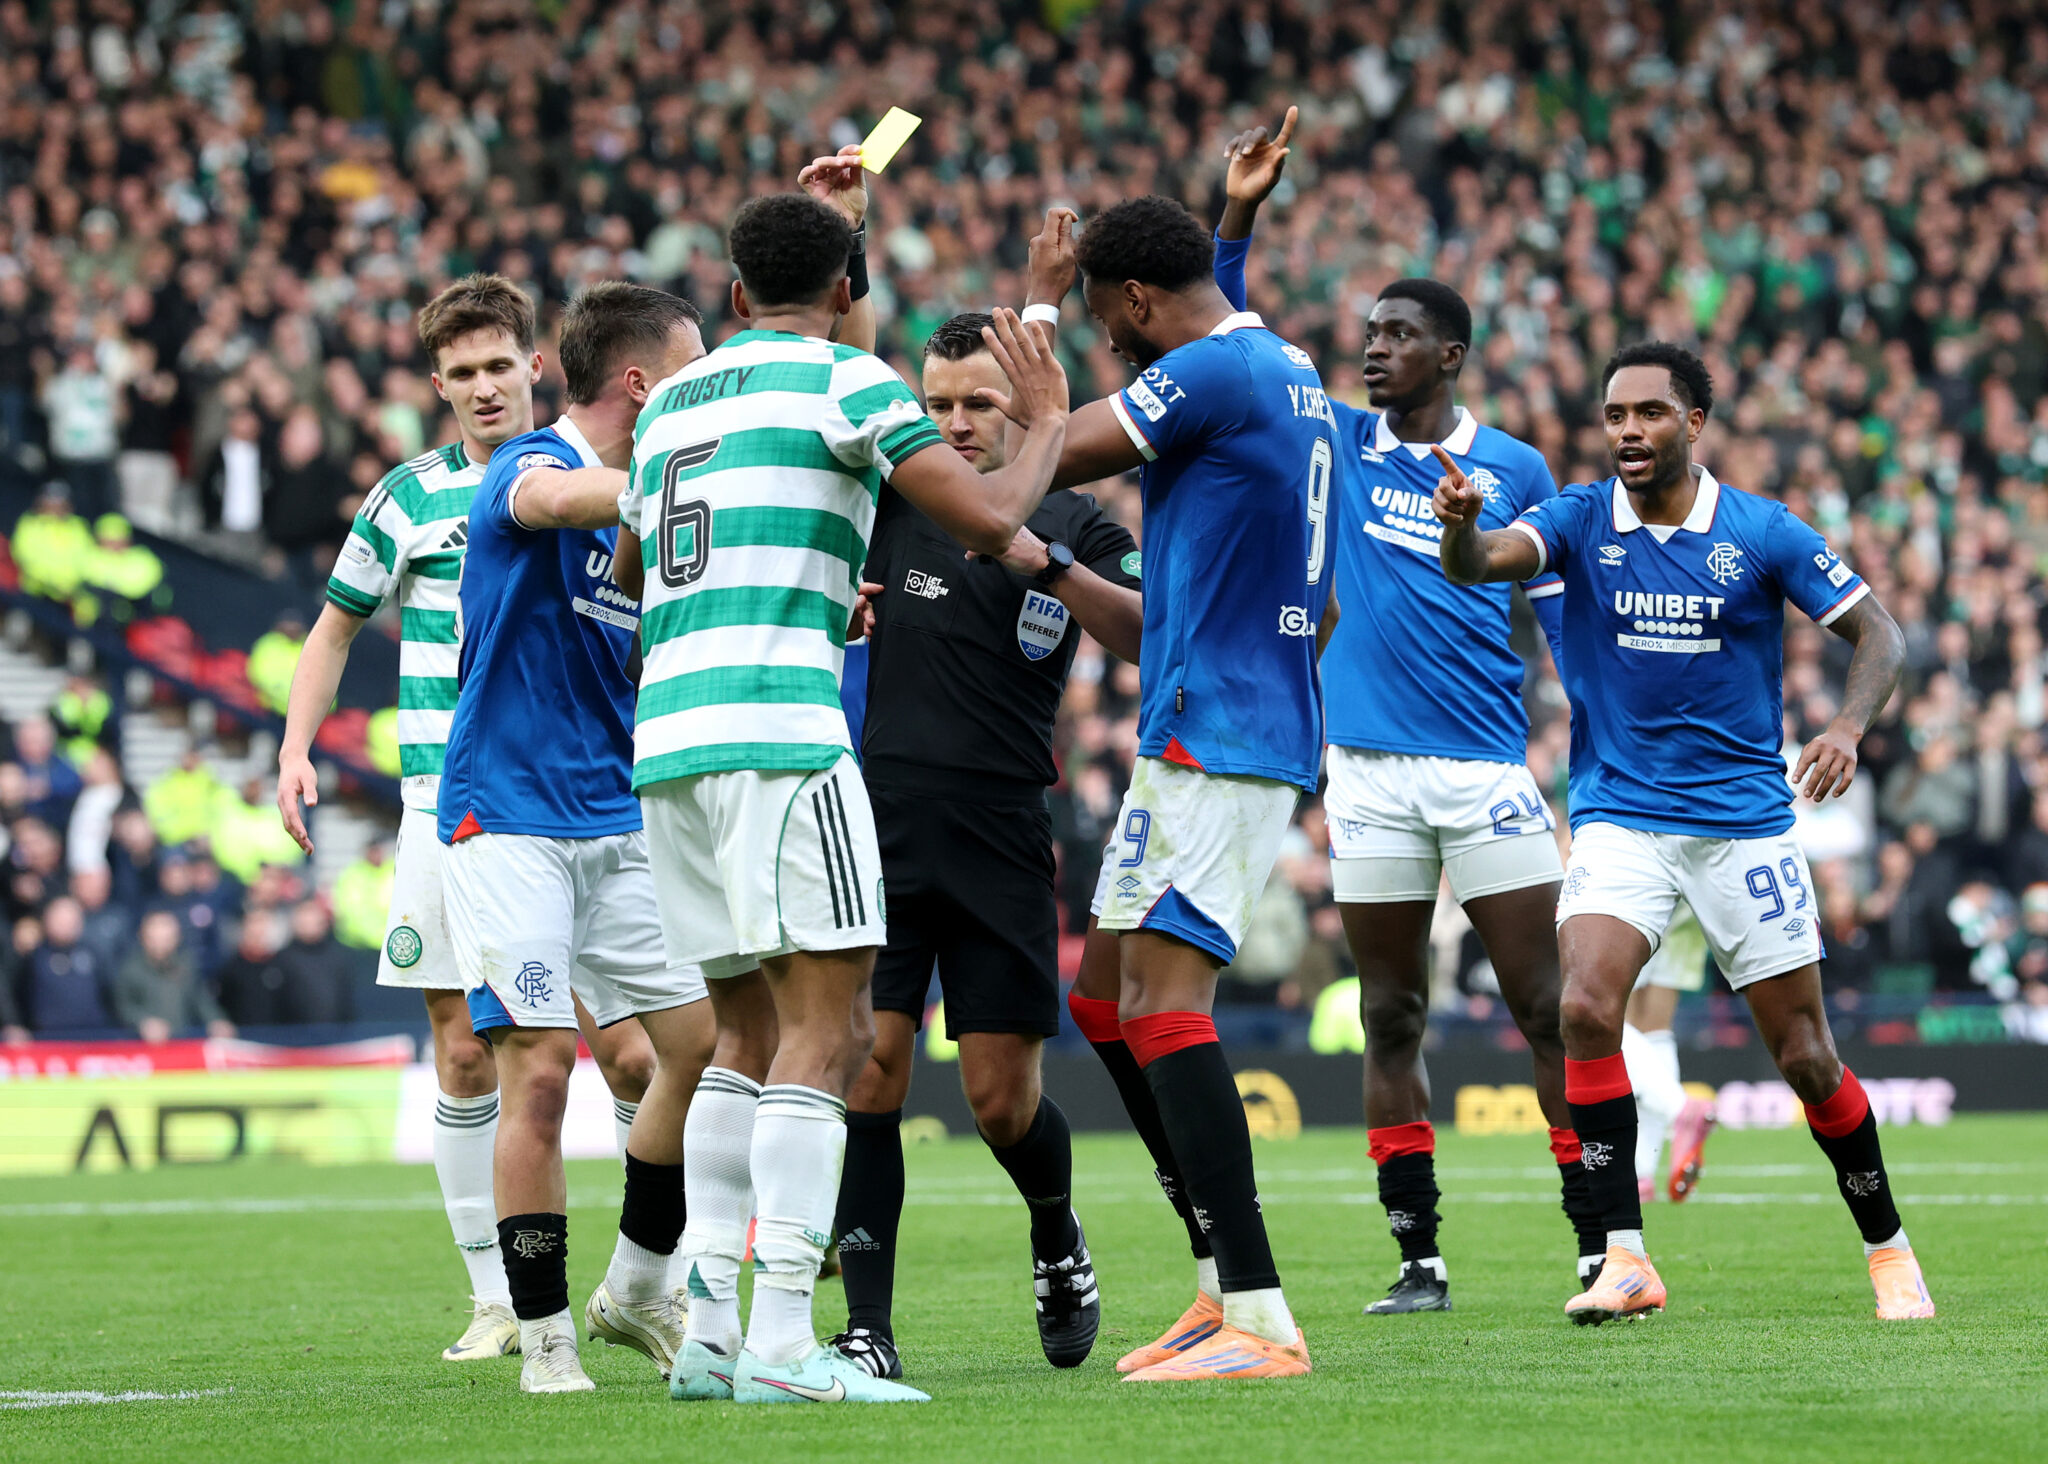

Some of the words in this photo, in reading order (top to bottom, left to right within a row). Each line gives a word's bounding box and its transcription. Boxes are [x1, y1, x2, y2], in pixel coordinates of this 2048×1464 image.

[662, 366, 755, 412] TRUSTY
[1286, 384, 1337, 433] Y.CHE
[658, 436, 723, 591] 6
[1306, 436, 1333, 585] 9
[1371, 486, 1442, 522] UNIB
[1598, 557, 1622, 566] umbro
[585, 604, 610, 620] ZERO%
[1027, 595, 1065, 621] FIFA
[1615, 590, 1725, 620] UNIBET
[1021, 620, 1060, 640] REFEREE
[1630, 638, 1663, 649] ZERO%
[1666, 641, 1707, 651] MISSION
[1026, 644, 1044, 657] 2025
[1489, 791, 1551, 835] 24
[1119, 809, 1151, 868] 9
[1117, 890, 1137, 898] umbro
[1745, 856, 1806, 922] 99
[838, 1241, 880, 1253] adidas
